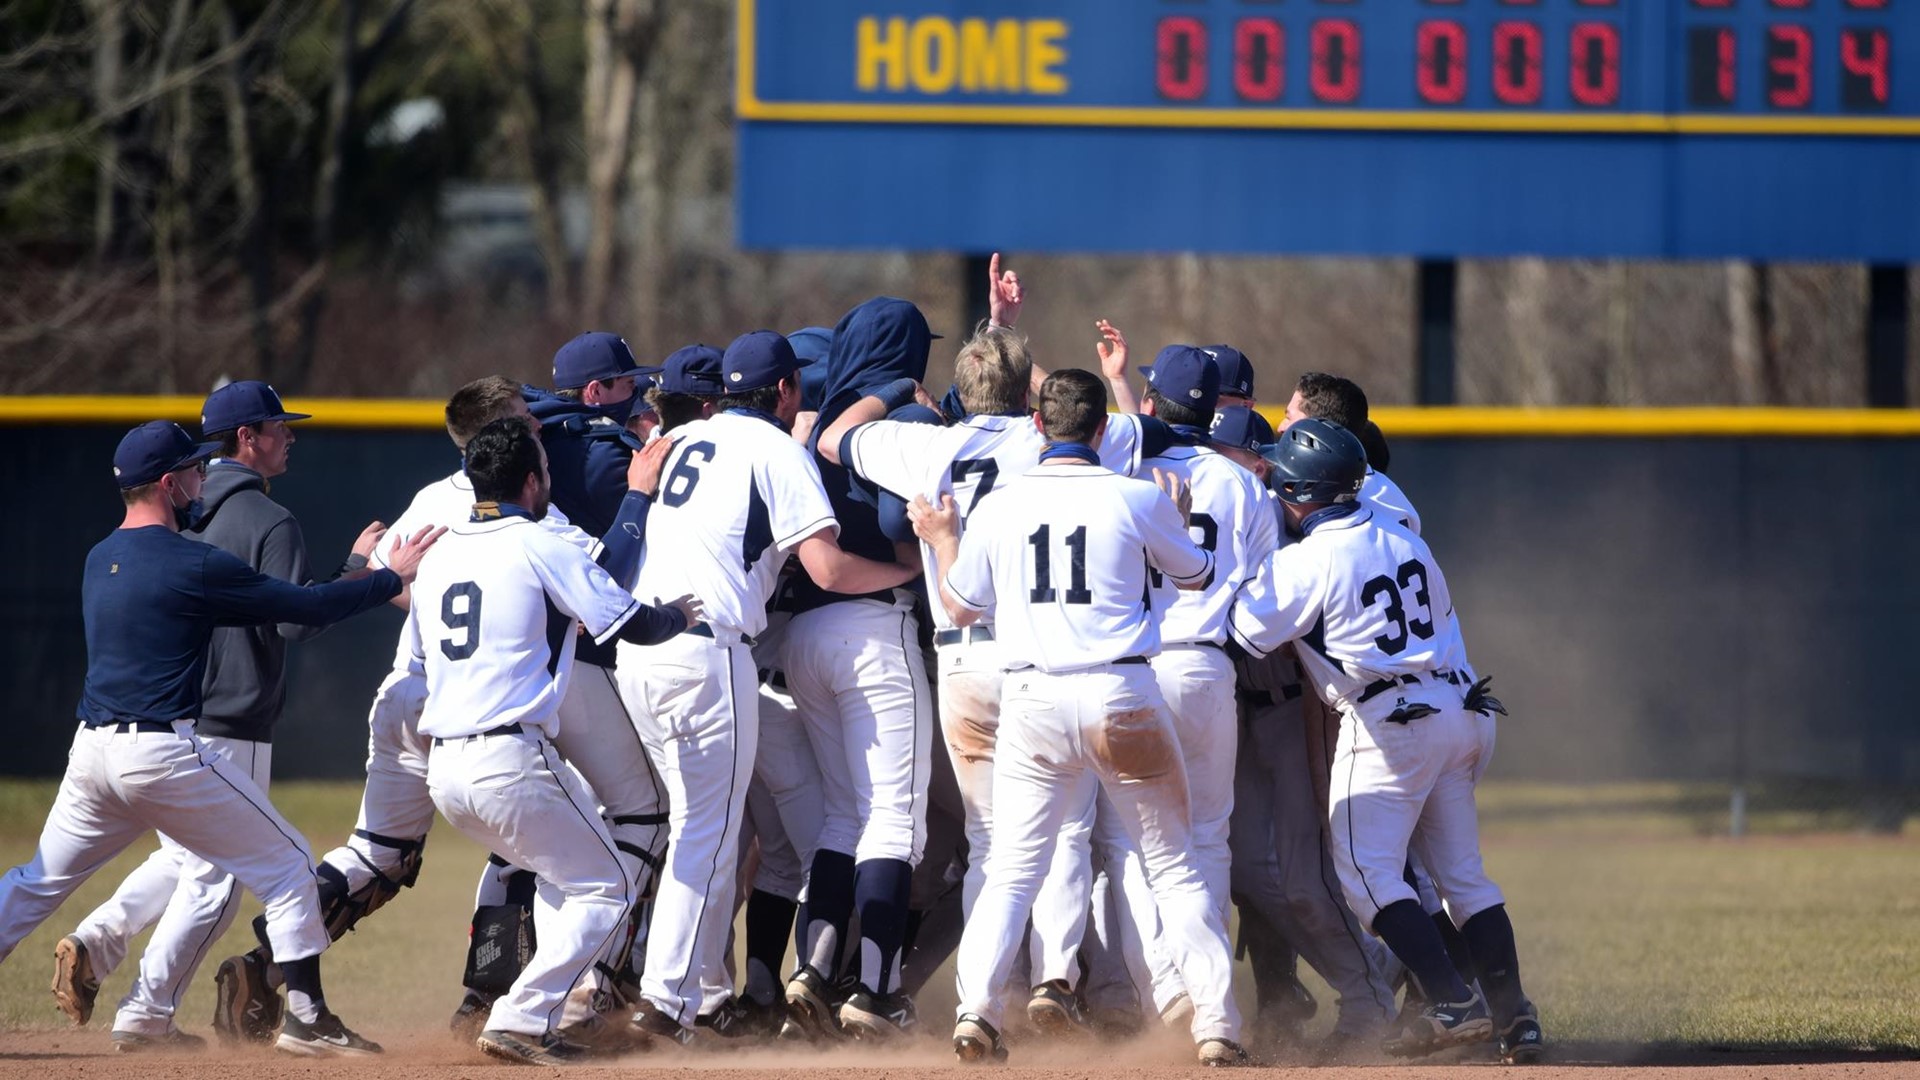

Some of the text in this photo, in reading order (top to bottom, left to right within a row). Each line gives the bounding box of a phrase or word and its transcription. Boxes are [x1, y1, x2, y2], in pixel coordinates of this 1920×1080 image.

[856, 16, 1068, 94] HOME
[951, 457, 1000, 532] 7
[1028, 523, 1092, 605] 11
[440, 580, 483, 662] 9
[1360, 558, 1435, 657] 33
[476, 938, 496, 959] KNEE
[476, 944, 503, 970] SAVER
